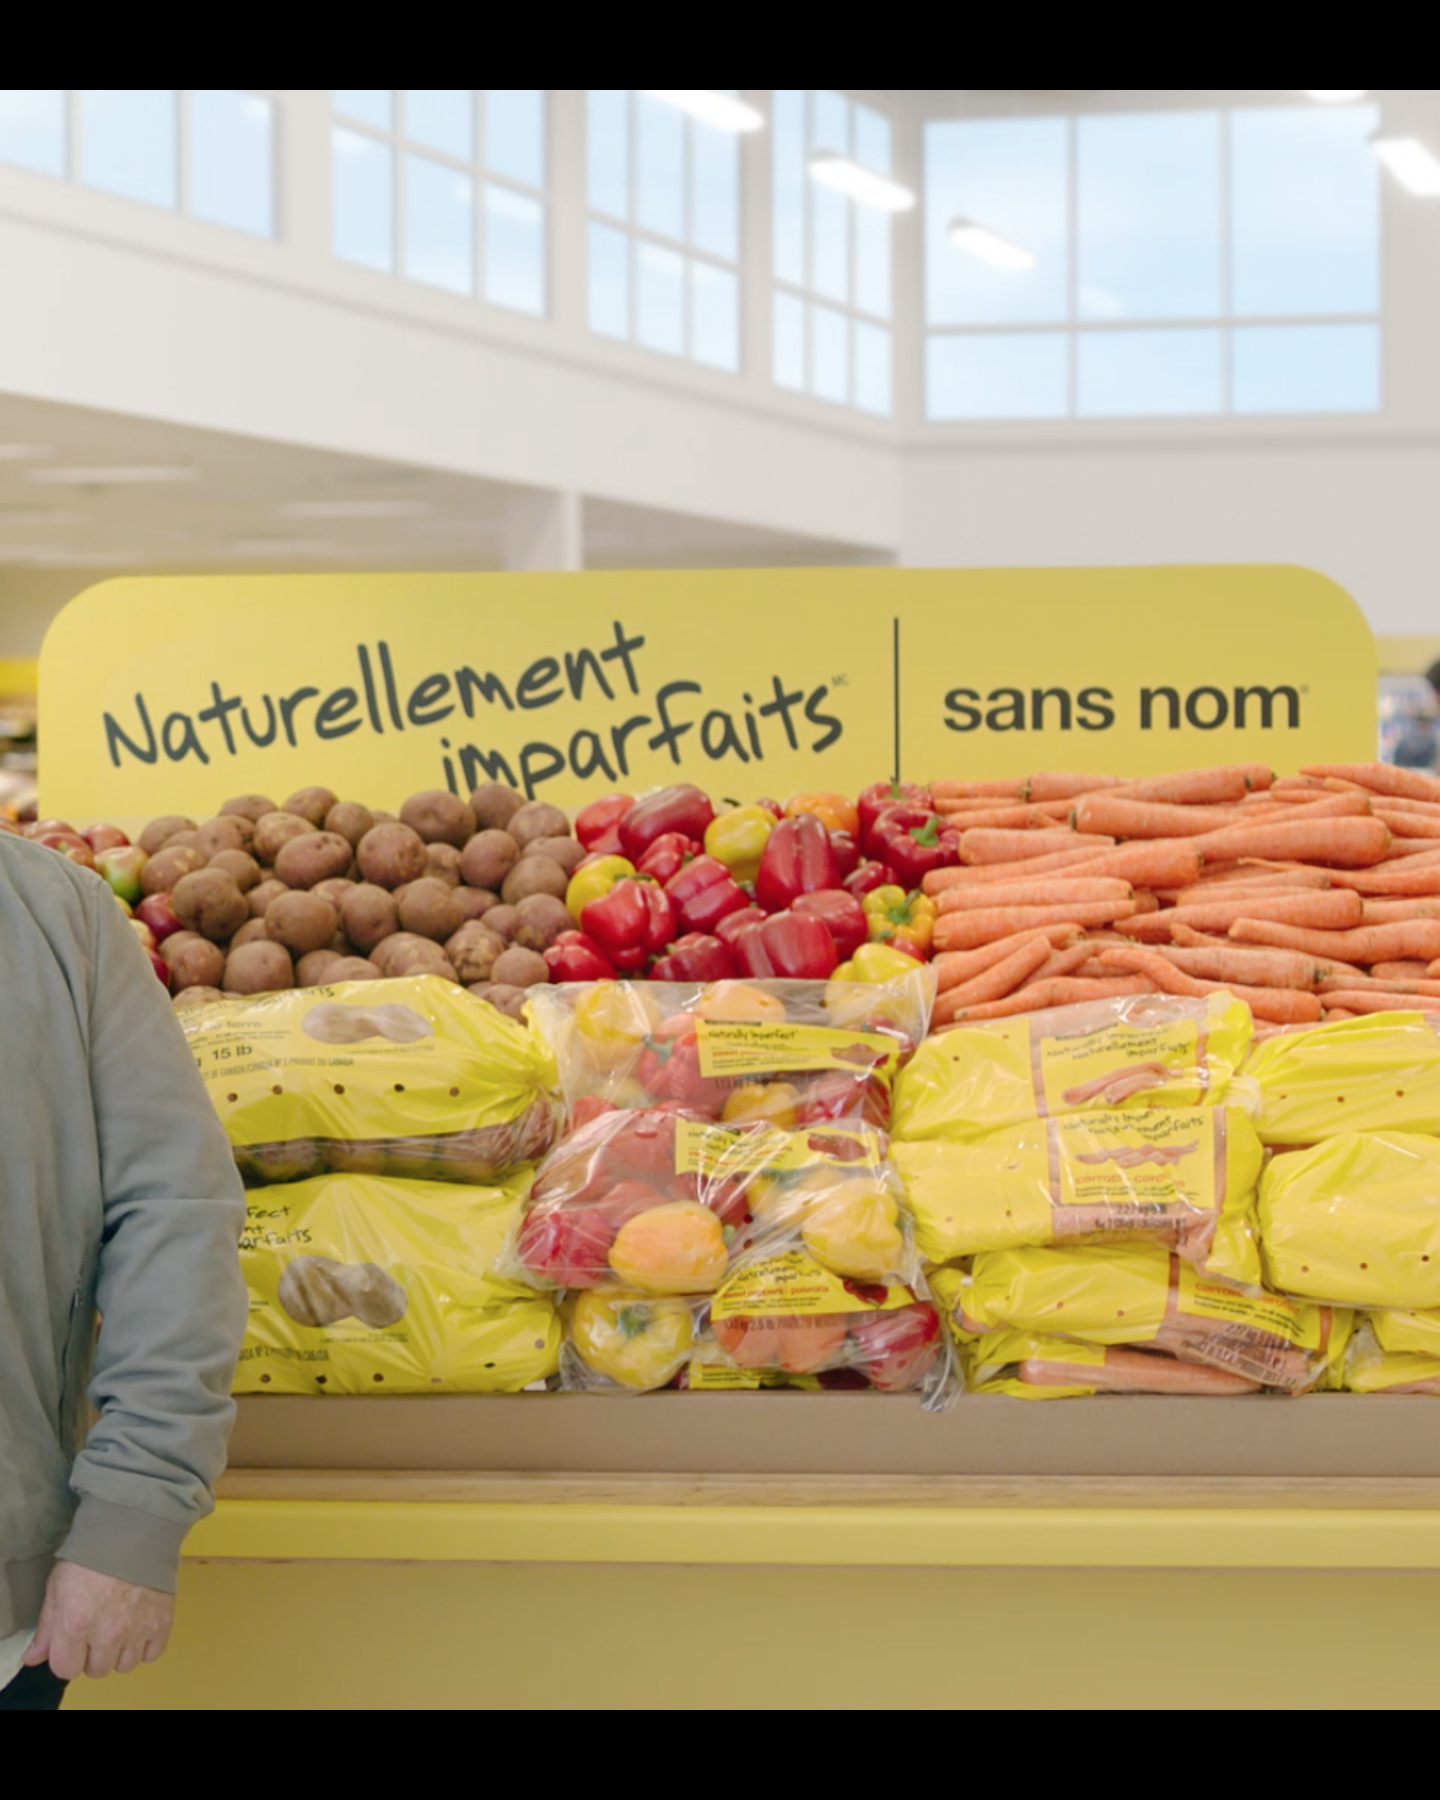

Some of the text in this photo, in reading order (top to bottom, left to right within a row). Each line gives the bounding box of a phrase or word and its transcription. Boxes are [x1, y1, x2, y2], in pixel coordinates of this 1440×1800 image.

[103, 621, 645, 768] Naturellement
[440, 675, 844, 800] imparfaits
[944, 685, 1301, 732] sans nom
[212, 1045, 253, 1060] 15 lb
